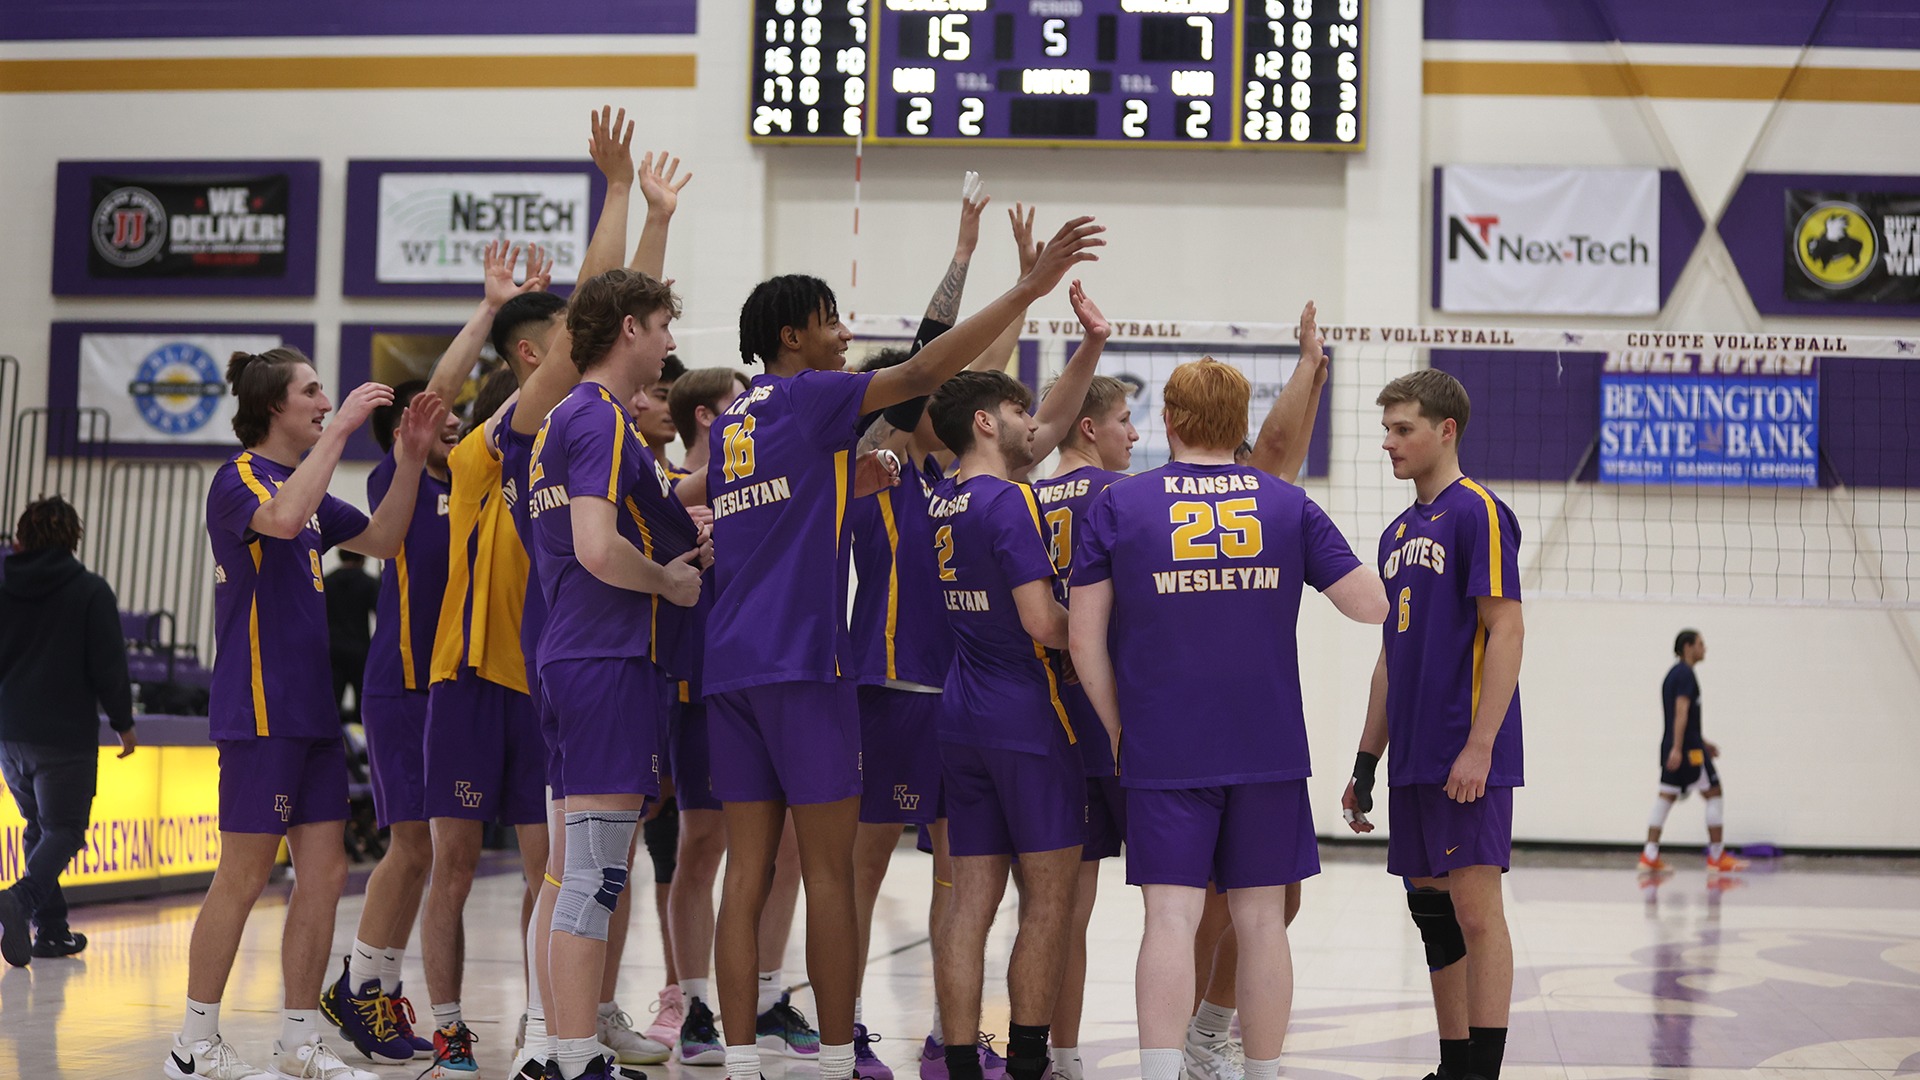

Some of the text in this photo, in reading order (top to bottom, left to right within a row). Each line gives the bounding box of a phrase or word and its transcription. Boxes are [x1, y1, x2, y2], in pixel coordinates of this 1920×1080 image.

[766, 17, 867, 45] 11 0 7
[928, 14, 971, 61] 15
[1043, 18, 1067, 57] 5
[1186, 15, 1214, 61] 7
[1268, 20, 1358, 50] 7 0 14
[800, 46, 821, 75] 0
[1254, 51, 1284, 80] 12
[1291, 51, 1312, 81] 0
[763, 76, 793, 103] 17
[799, 76, 820, 105] 0
[1244, 81, 1357, 111] 21 0 3
[753, 105, 792, 135] 24
[807, 108, 819, 133] 1
[906, 97, 932, 136] 2
[958, 97, 985, 136] 2
[1122, 99, 1149, 139] 2
[1185, 100, 1212, 139] 2
[1244, 111, 1283, 141] 23
[1290, 111, 1311, 141] 0
[208, 187, 249, 214] WE
[170, 215, 285, 241] DELIVER!
[1883, 215, 1920, 235] BUF
[402, 234, 575, 266] wirees
[1499, 234, 1649, 264] Nex-Tech
[1886, 235, 1920, 254] WI
[1049, 321, 1181, 337] VOLYBALL
[1293, 326, 1515, 344] CYOTE VOLLEYBALL
[1627, 332, 1848, 352] COYOTE VOLLEYBALL
[1604, 383, 1813, 421] BENNINGTON
[722, 413, 756, 485] 16
[1600, 420, 1815, 459] STATE BANK
[1163, 474, 1260, 495] KANSAS
[1605, 460, 1817, 480] WEALTH BANKING LENDING
[712, 476, 791, 520] WESLEYAN
[1034, 479, 1090, 505] NSAS
[1169, 497, 1263, 561] 25
[934, 524, 957, 581] 2
[1383, 536, 1446, 580] OYOTES
[309, 548, 324, 593] 9
[1152, 567, 1280, 595] WESLEYAN
[1398, 586, 1411, 633] 6
